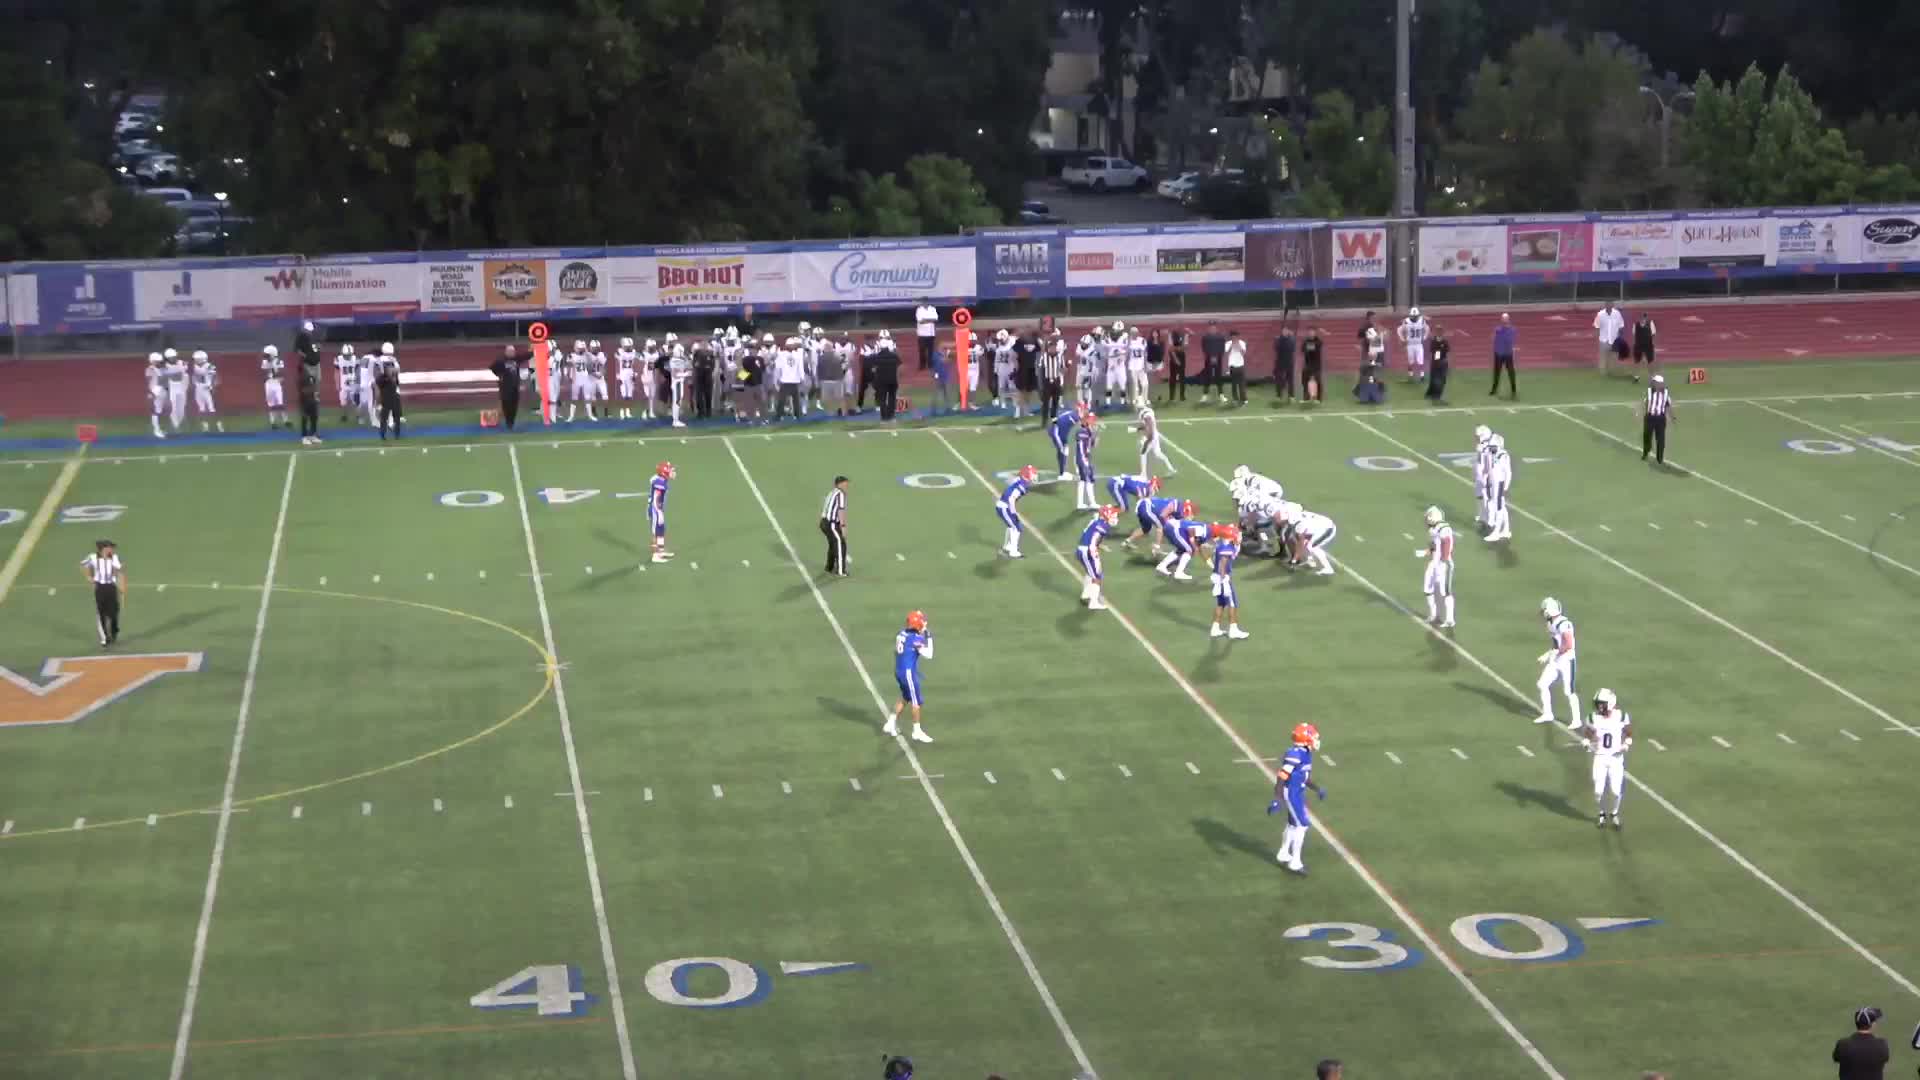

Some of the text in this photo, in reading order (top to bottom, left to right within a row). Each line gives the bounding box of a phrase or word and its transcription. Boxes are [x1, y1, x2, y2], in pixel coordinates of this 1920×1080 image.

[658, 264, 744, 288] BBQ HUT
[831, 252, 939, 294] Community
[311, 278, 387, 289] Illumination
[493, 278, 513, 289] THE
[1603, 732, 1613, 749] 0
[470, 956, 762, 1017] 40
